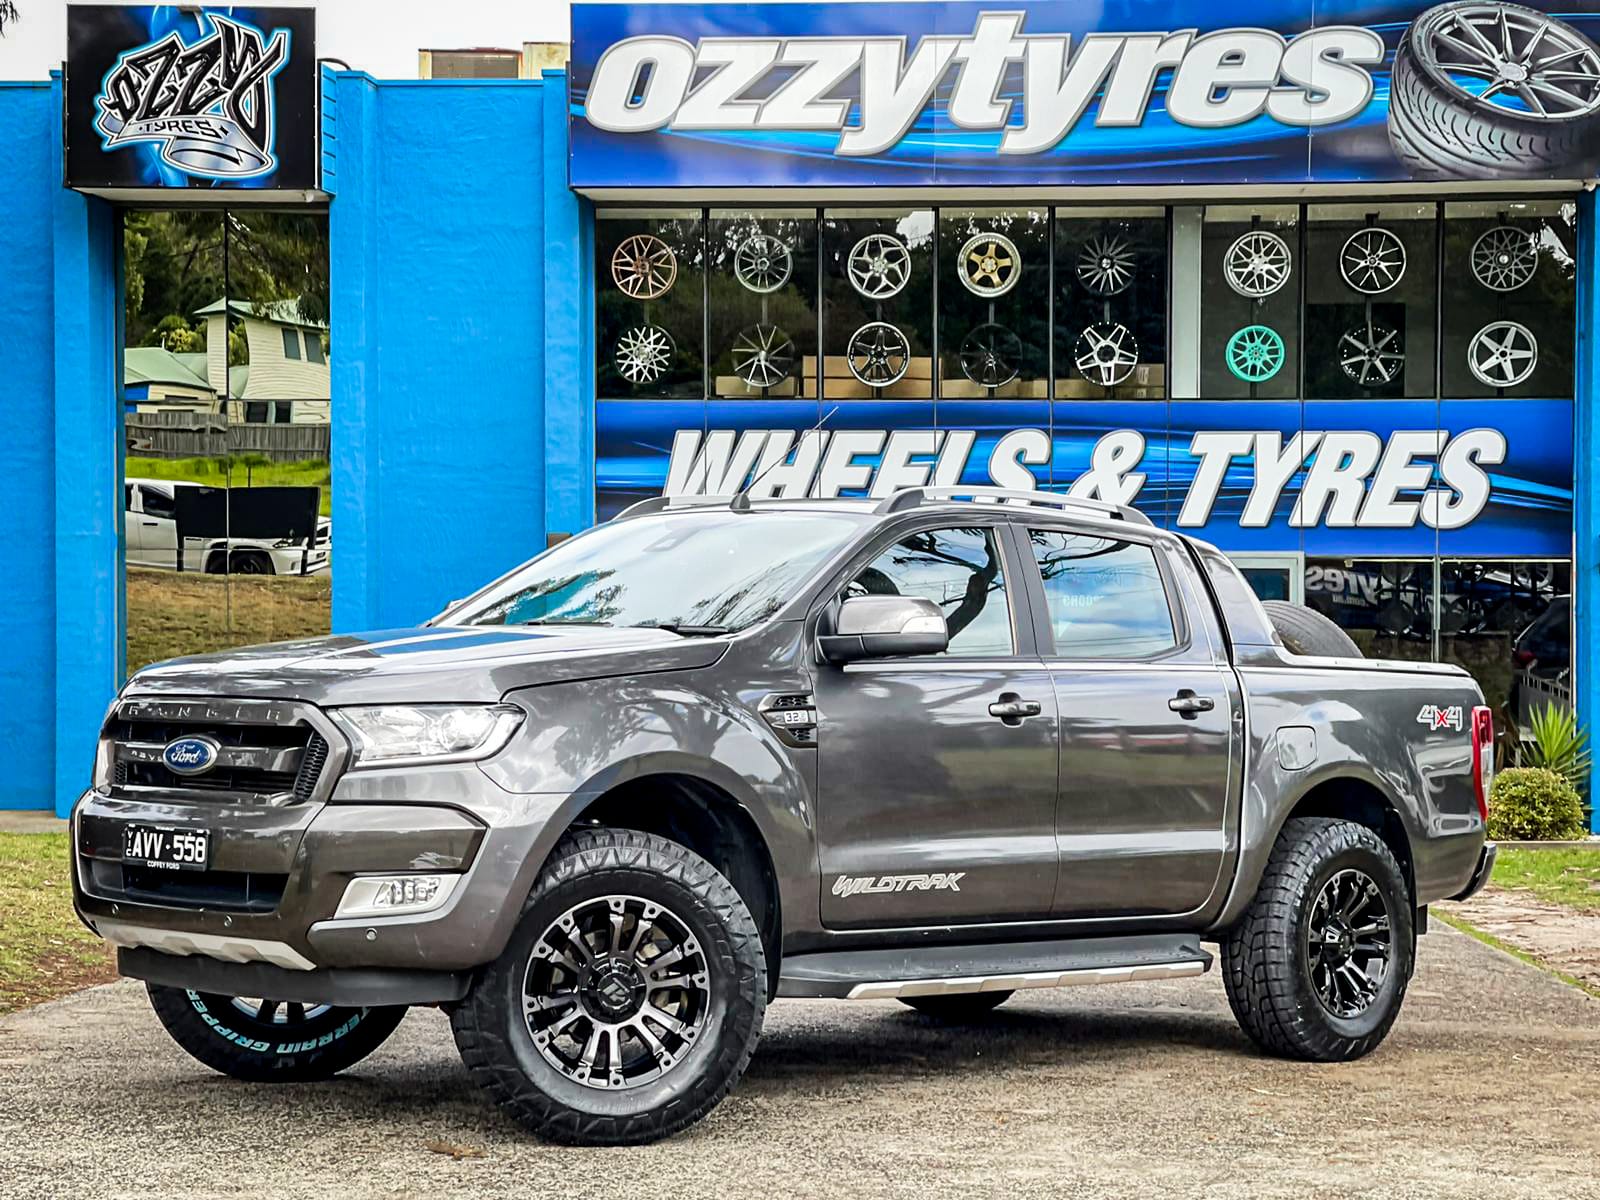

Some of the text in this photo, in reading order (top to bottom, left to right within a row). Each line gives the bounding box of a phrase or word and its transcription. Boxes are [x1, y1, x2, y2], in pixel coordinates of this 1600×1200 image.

[102, 17, 287, 152] OZZY
[584, 10, 1385, 156] ozzytyres
[143, 119, 223, 140] TYRES
[663, 428, 1051, 503] WHEELS
[1176, 428, 1508, 529] TYRES
[170, 744, 200, 764] Ford
[166, 862, 180, 870] FORD
[831, 872, 967, 898] WILDTRAK
[186, 988, 272, 1053] GRIPPER
